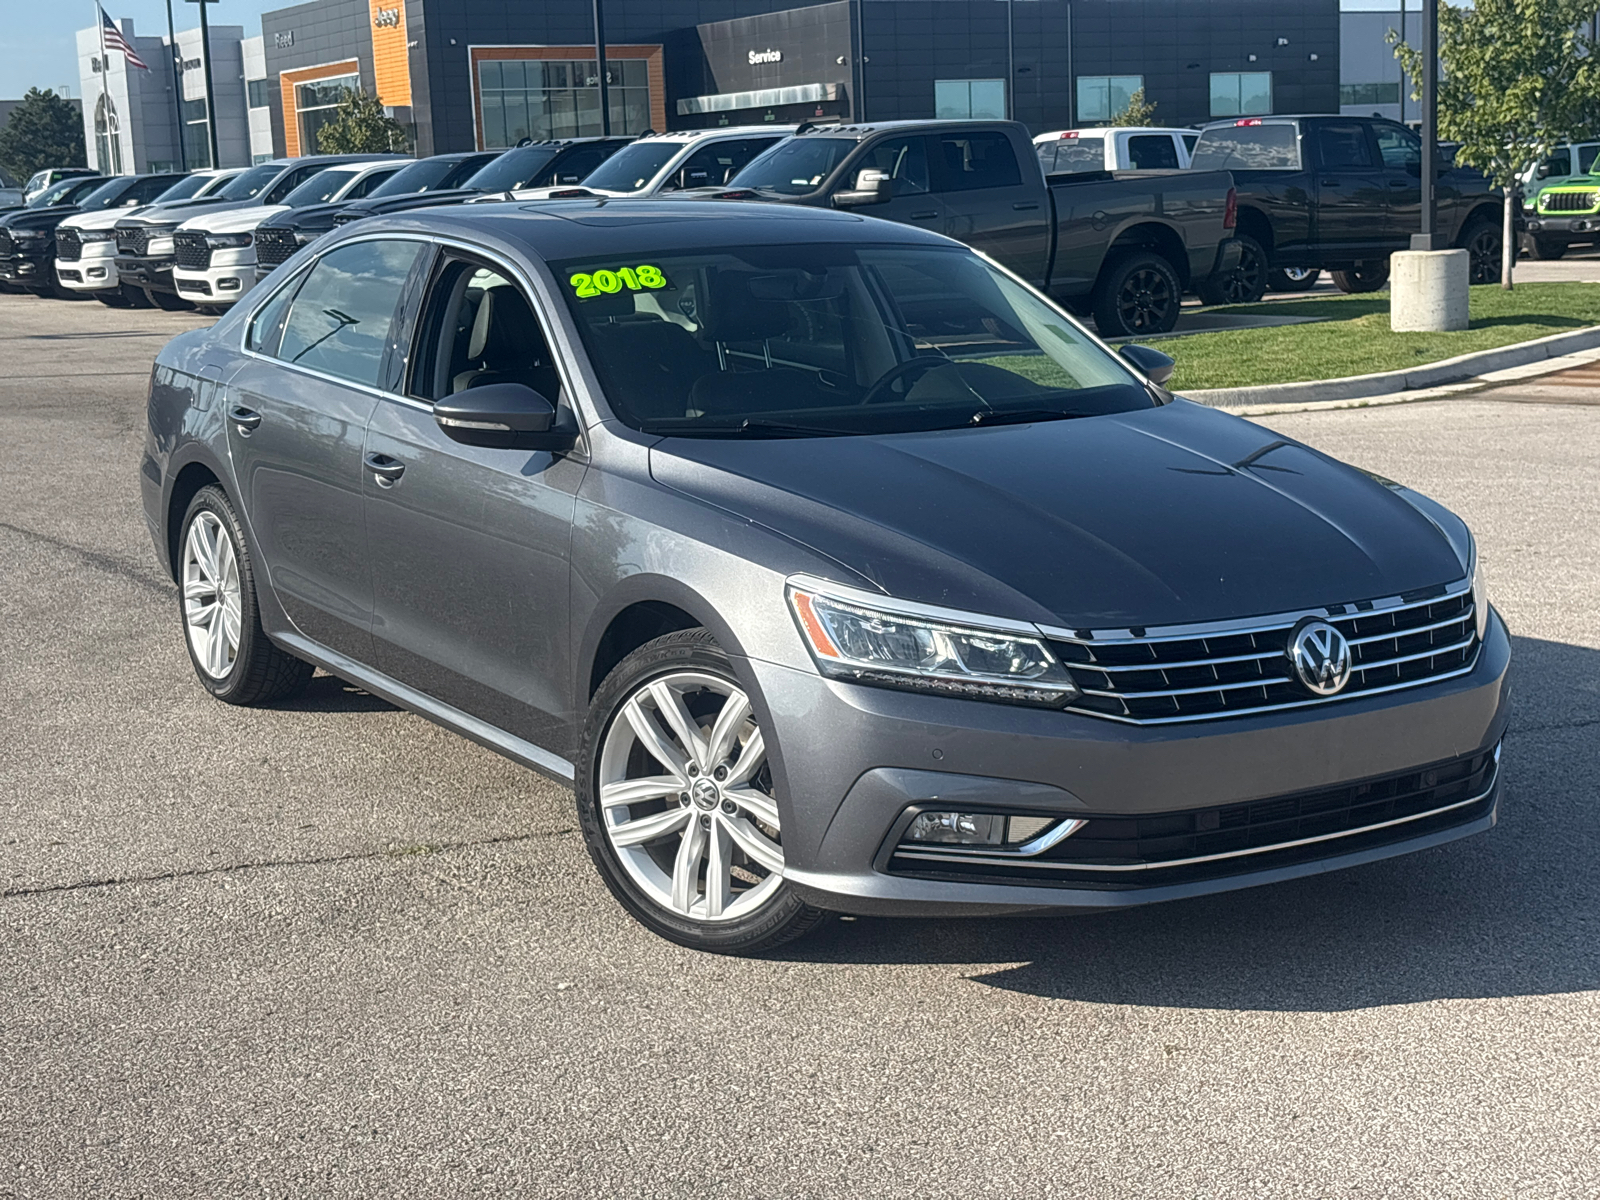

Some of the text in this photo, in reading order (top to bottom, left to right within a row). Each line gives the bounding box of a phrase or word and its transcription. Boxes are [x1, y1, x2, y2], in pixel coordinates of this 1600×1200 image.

[375, 6, 399, 28] Jeep
[275, 30, 294, 49] Reed
[748, 48, 781, 65] Service
[570, 265, 666, 298] 2018
